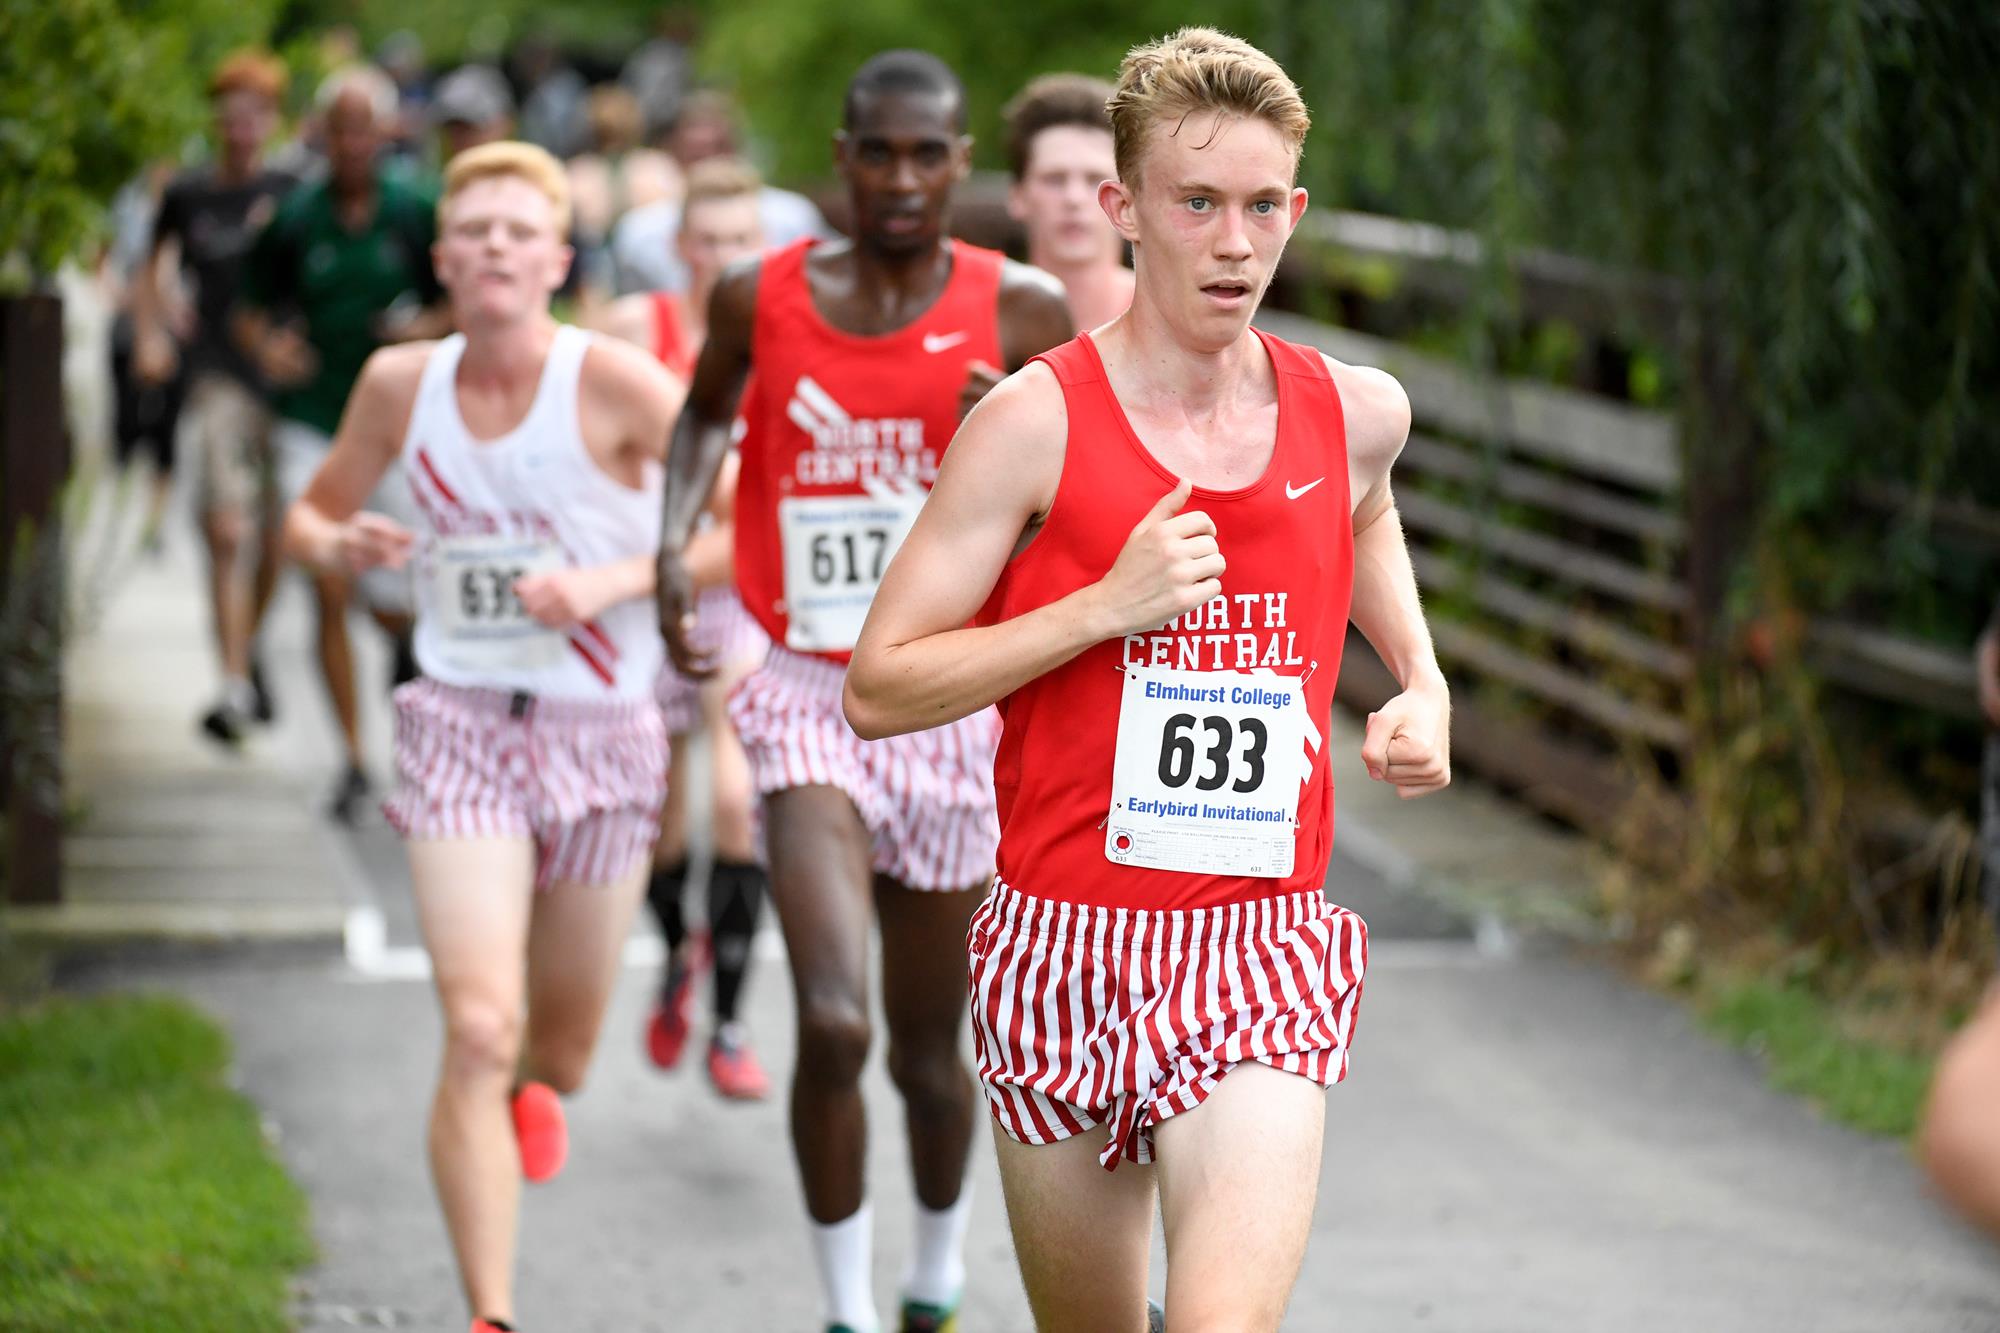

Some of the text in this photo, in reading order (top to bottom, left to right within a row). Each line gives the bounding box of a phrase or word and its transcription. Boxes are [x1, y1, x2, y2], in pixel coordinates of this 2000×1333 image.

[796, 449, 940, 485] CENTRAL
[811, 530, 888, 586] 617
[1123, 631, 1304, 671] CENTRAL
[1144, 681, 1292, 710] Elmhurst College
[1157, 713, 1269, 794] 633
[1127, 796, 1286, 823] Earlybird Invitational
